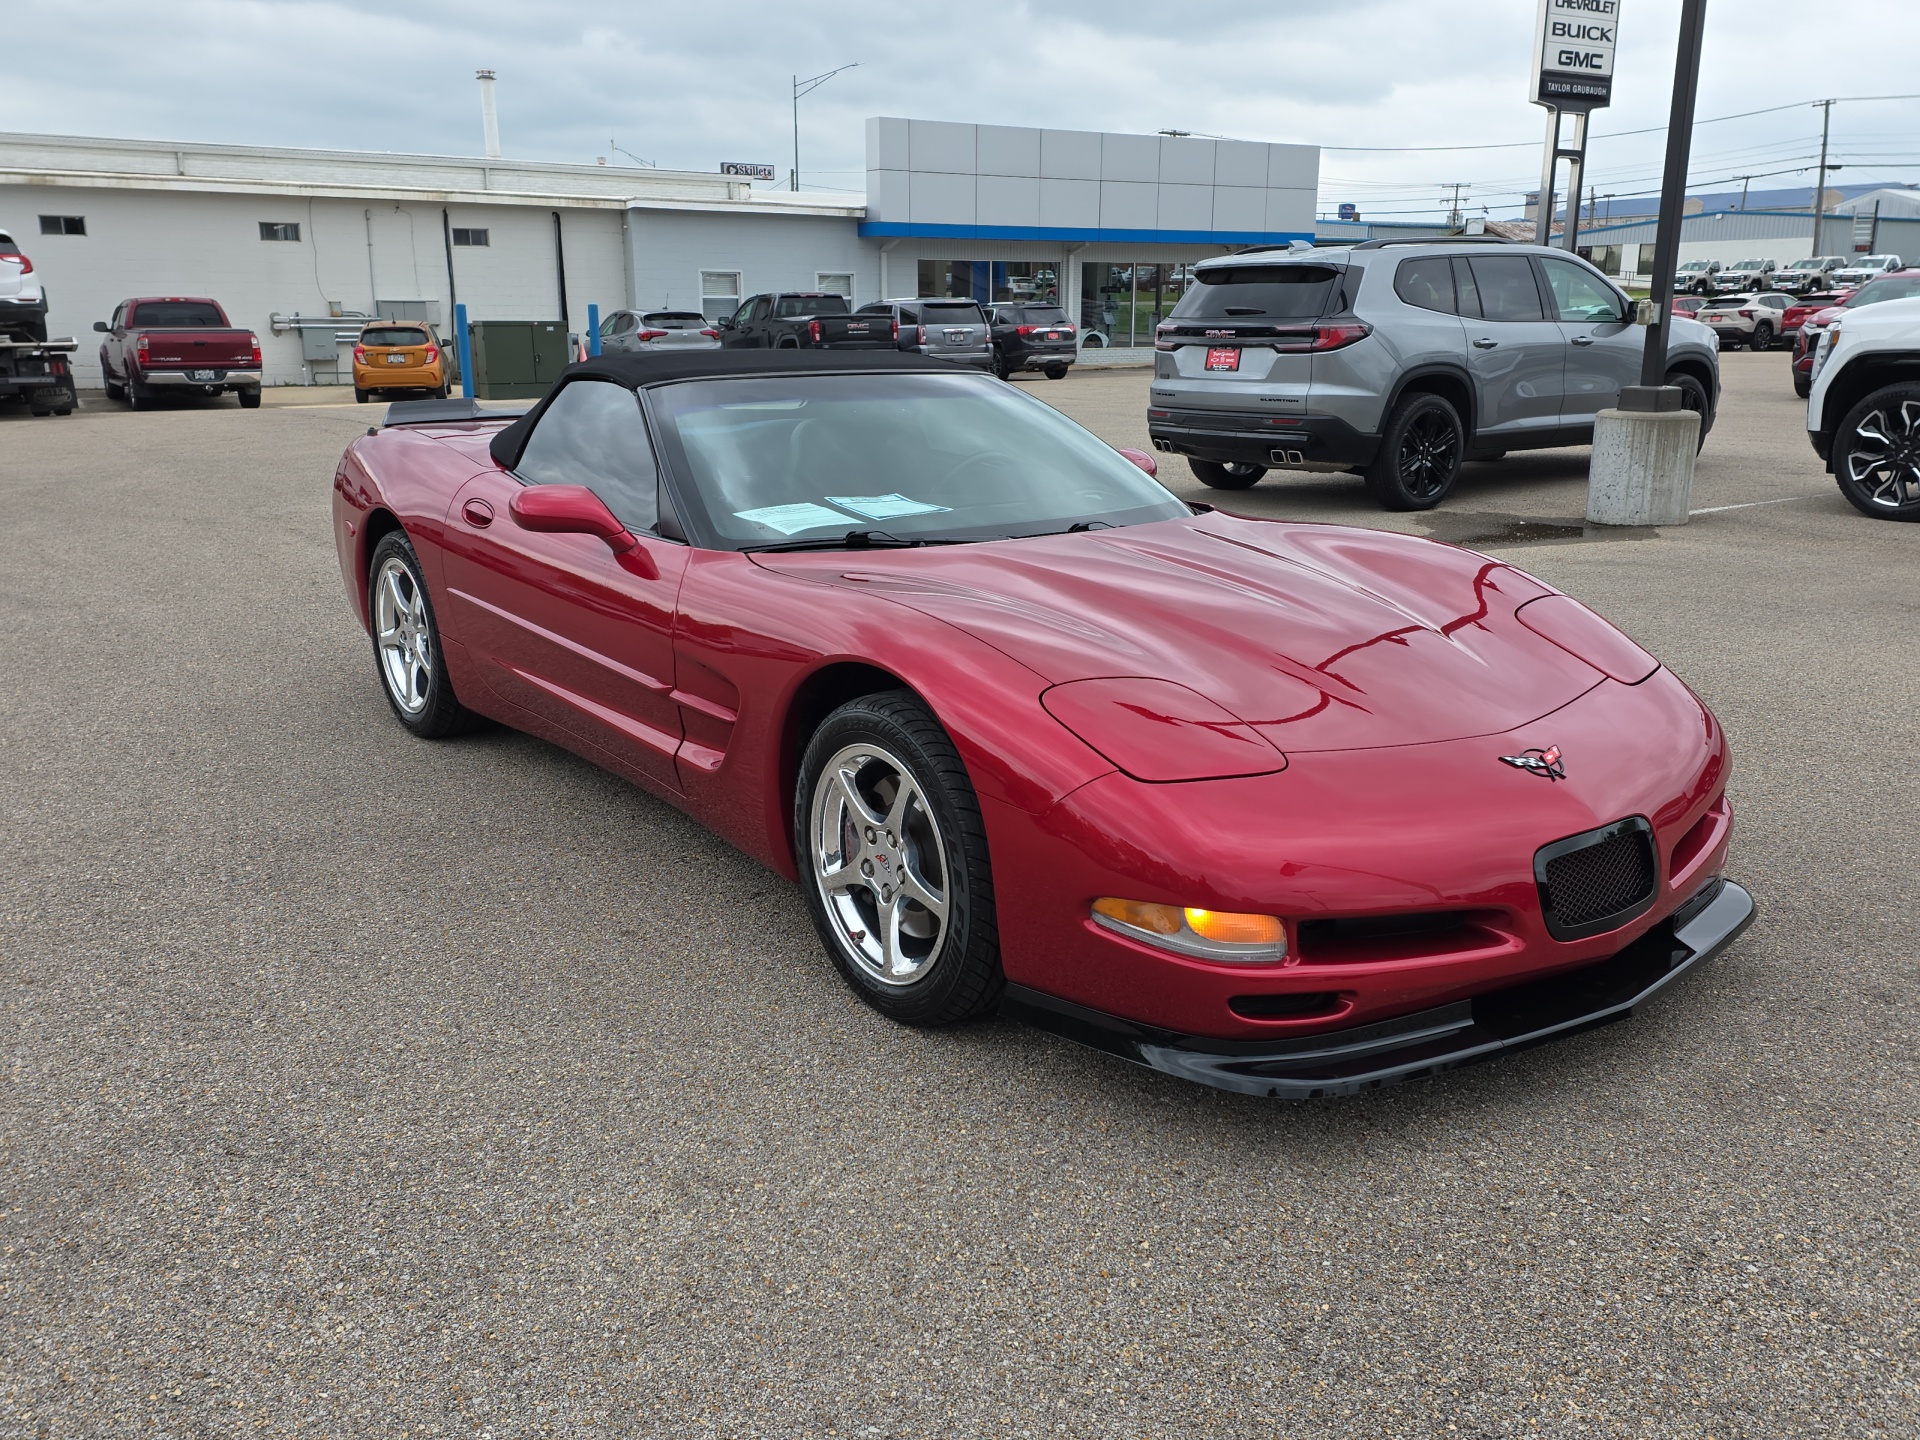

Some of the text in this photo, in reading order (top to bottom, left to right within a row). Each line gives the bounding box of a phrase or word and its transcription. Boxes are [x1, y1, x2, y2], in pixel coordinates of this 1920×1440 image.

[1555, 0, 1616, 14] CHEVROLET
[1552, 22, 1613, 42] BUICK
[1558, 50, 1604, 69] GMC
[1548, 83, 1606, 96] TAYLOR GRUBAUGH
[739, 165, 772, 177] Skillets
[1205, 330, 1236, 338] GMC
